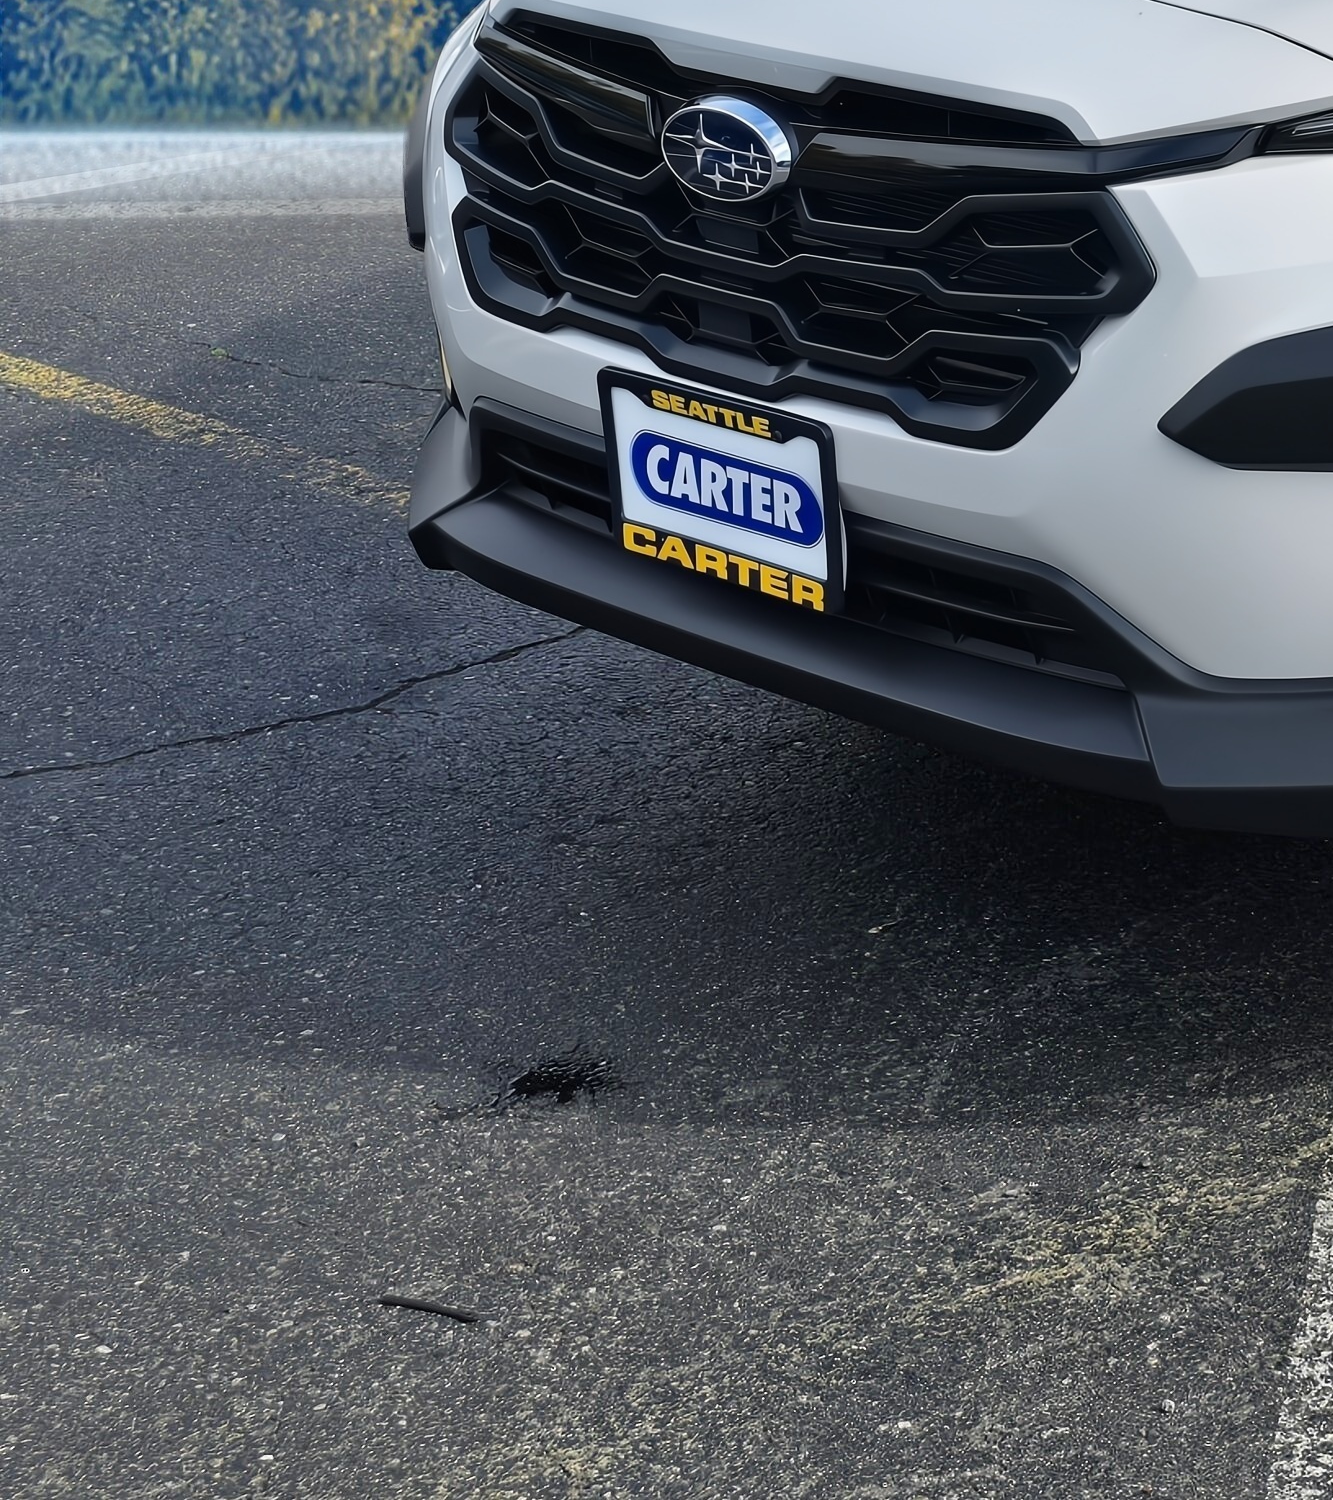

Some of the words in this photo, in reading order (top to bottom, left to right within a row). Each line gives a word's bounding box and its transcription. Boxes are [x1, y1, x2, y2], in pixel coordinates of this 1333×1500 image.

[650, 389, 772, 439] SEATTLE
[646, 444, 804, 534] CARTER
[622, 522, 825, 613] CARTER
